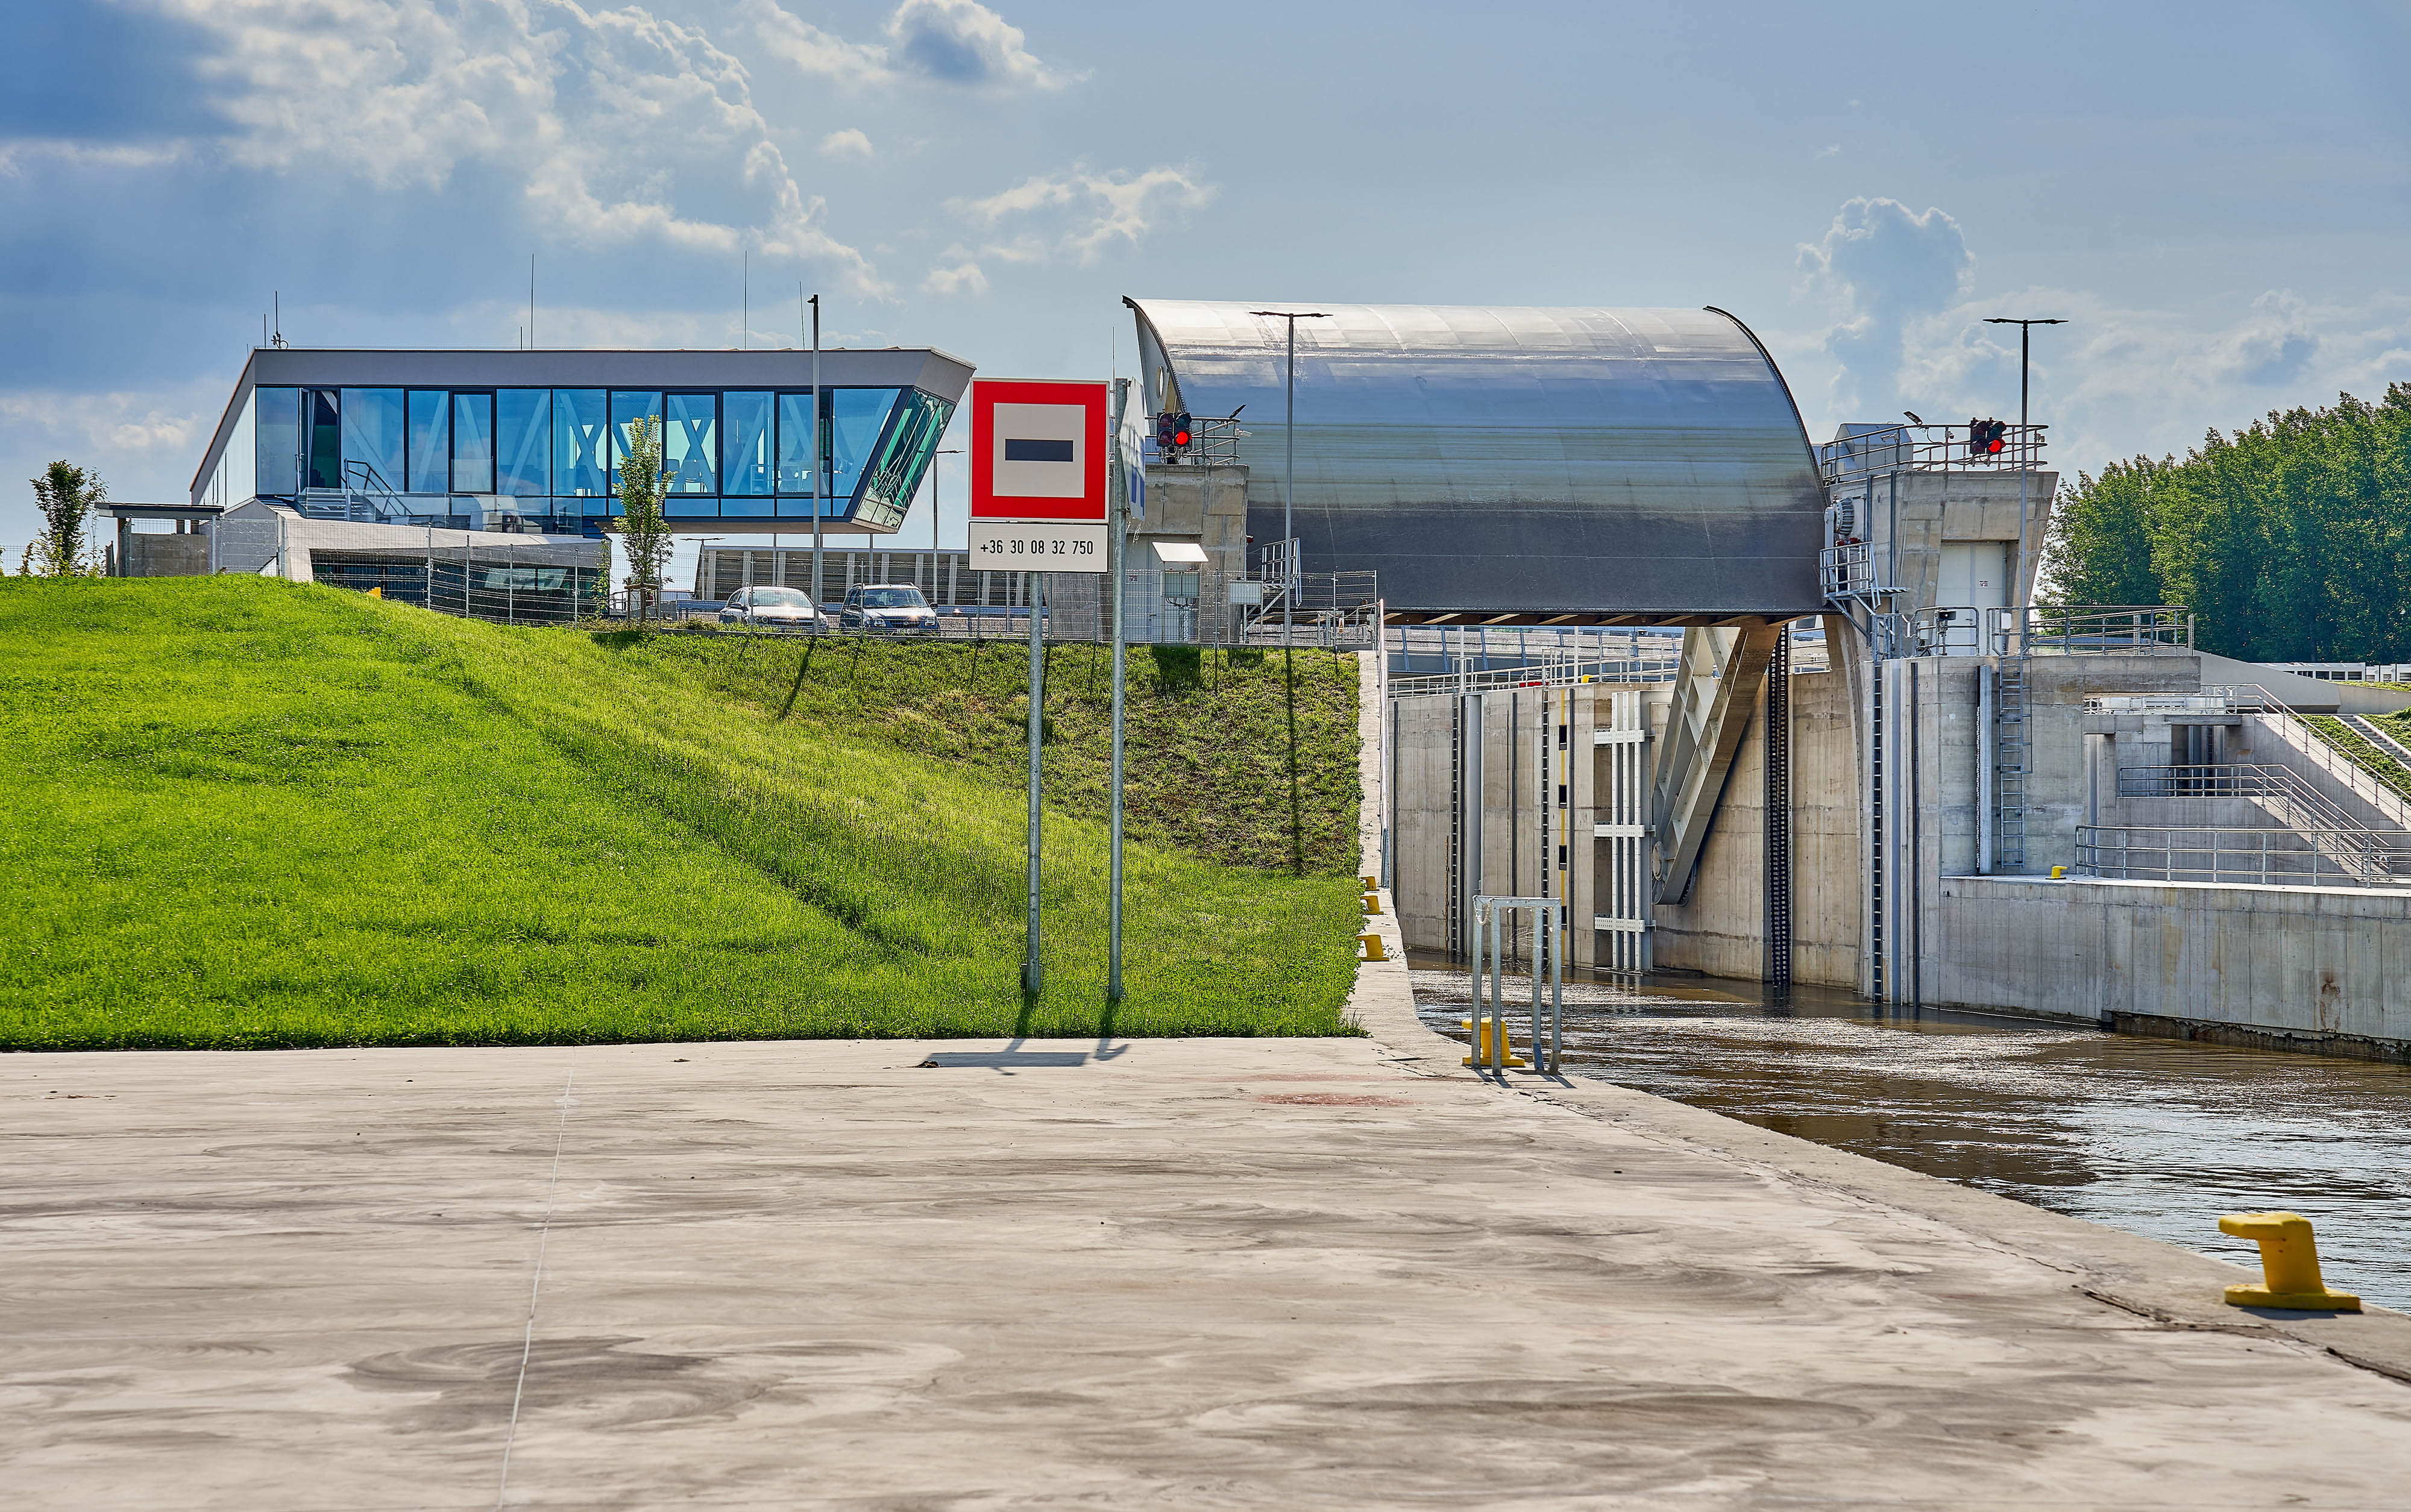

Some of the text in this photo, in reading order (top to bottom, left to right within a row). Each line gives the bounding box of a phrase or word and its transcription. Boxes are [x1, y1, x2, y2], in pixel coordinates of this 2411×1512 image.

[980, 539, 1093, 555] +36 30 08 32 750
